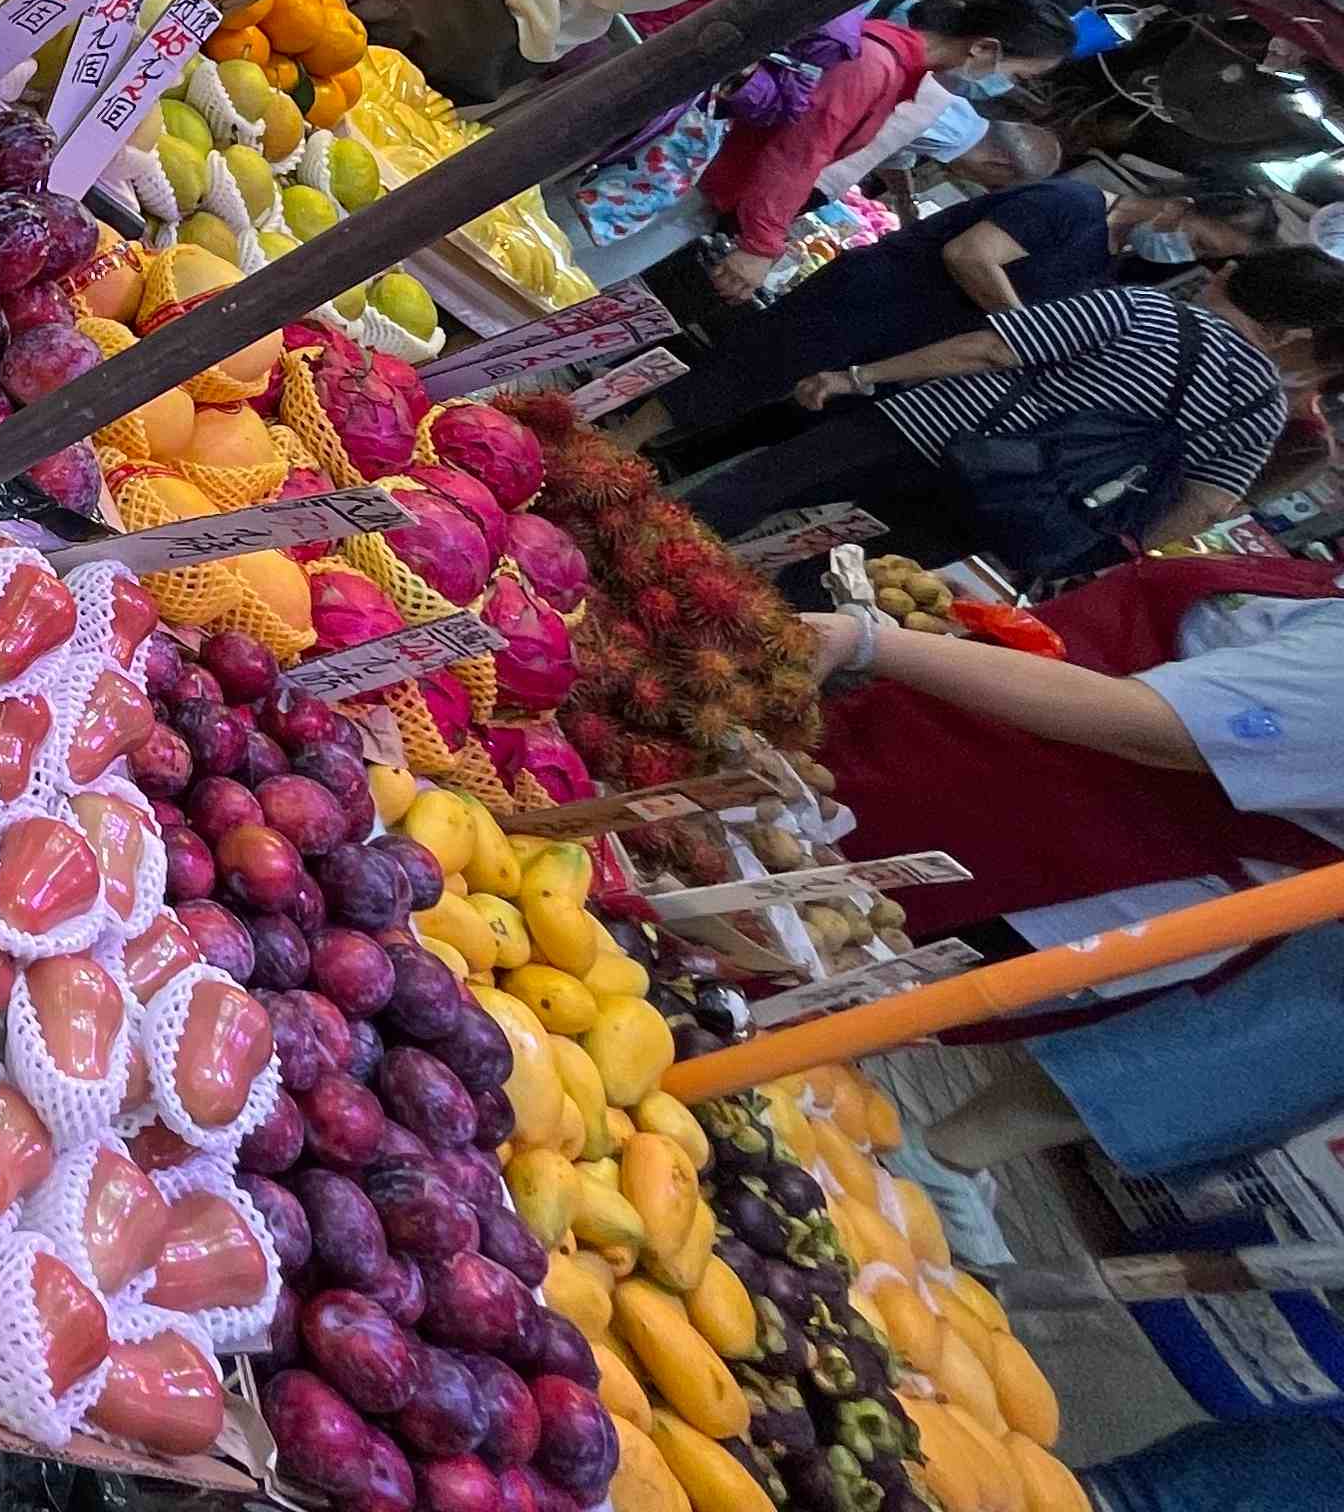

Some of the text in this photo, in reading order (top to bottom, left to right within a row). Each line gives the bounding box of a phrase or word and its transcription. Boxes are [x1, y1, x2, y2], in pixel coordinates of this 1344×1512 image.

[91, 21, 118, 51] 元
[150, 24, 193, 57] 45
[73, 52, 110, 88] 個
[140, 52, 166, 82] 元
[121, 74, 151, 101] 2
[97, 96, 137, 132] 個
